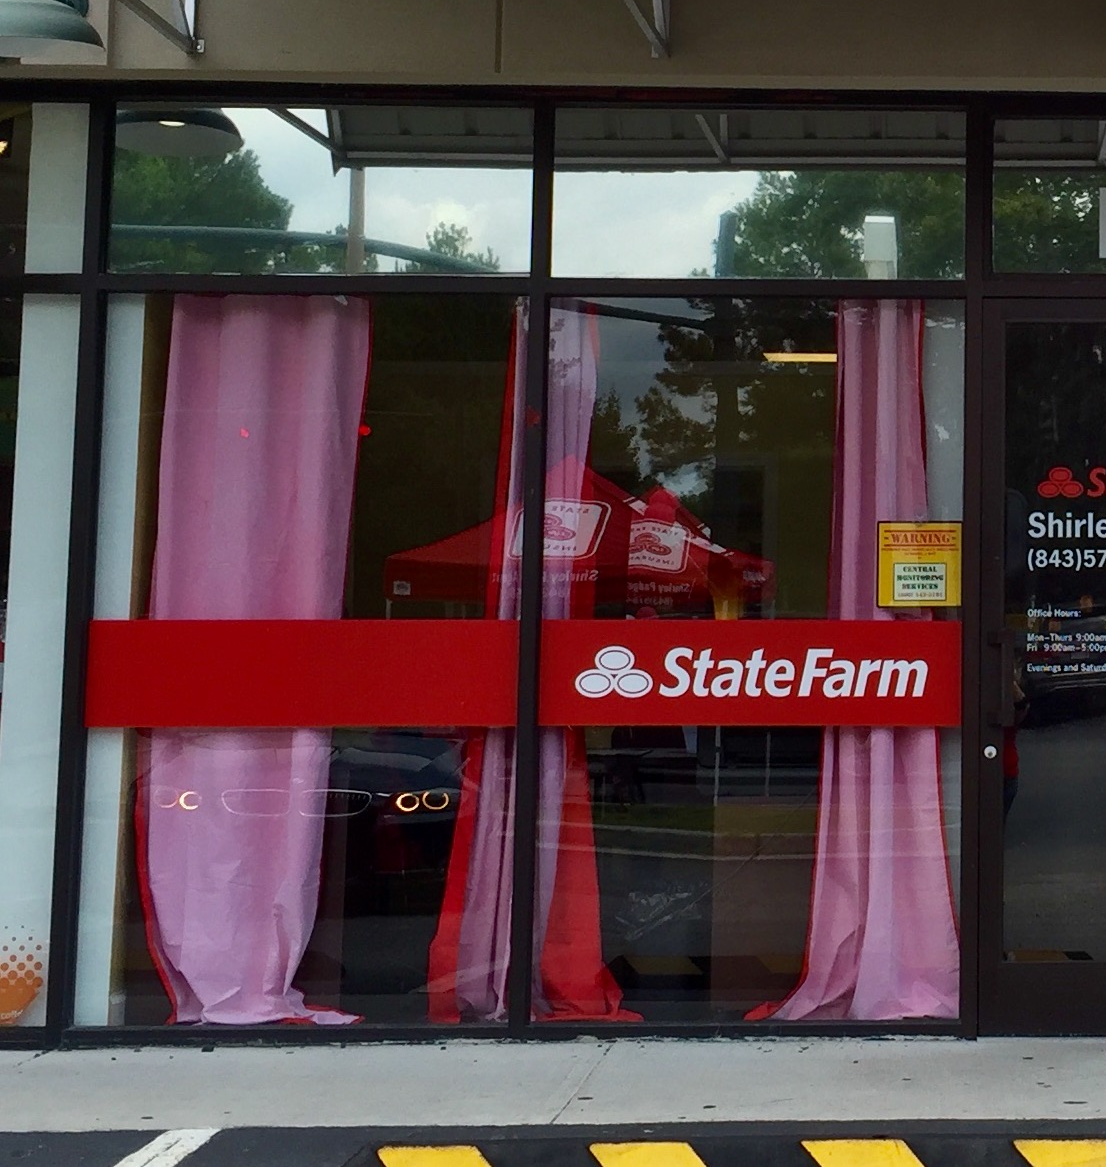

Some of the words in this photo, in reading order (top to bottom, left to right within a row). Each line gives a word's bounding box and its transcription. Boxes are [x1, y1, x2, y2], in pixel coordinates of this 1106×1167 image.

[891, 533, 950, 544] WARNING
[1027, 608, 1052, 617] Office
[1054, 609, 1082, 618] Hours:
[1026, 633, 1073, 642] Mon-Thurs
[1026, 643, 1038, 652] Fri
[1026, 663, 1062, 673] Evenings
[1063, 664, 1079, 672] and
